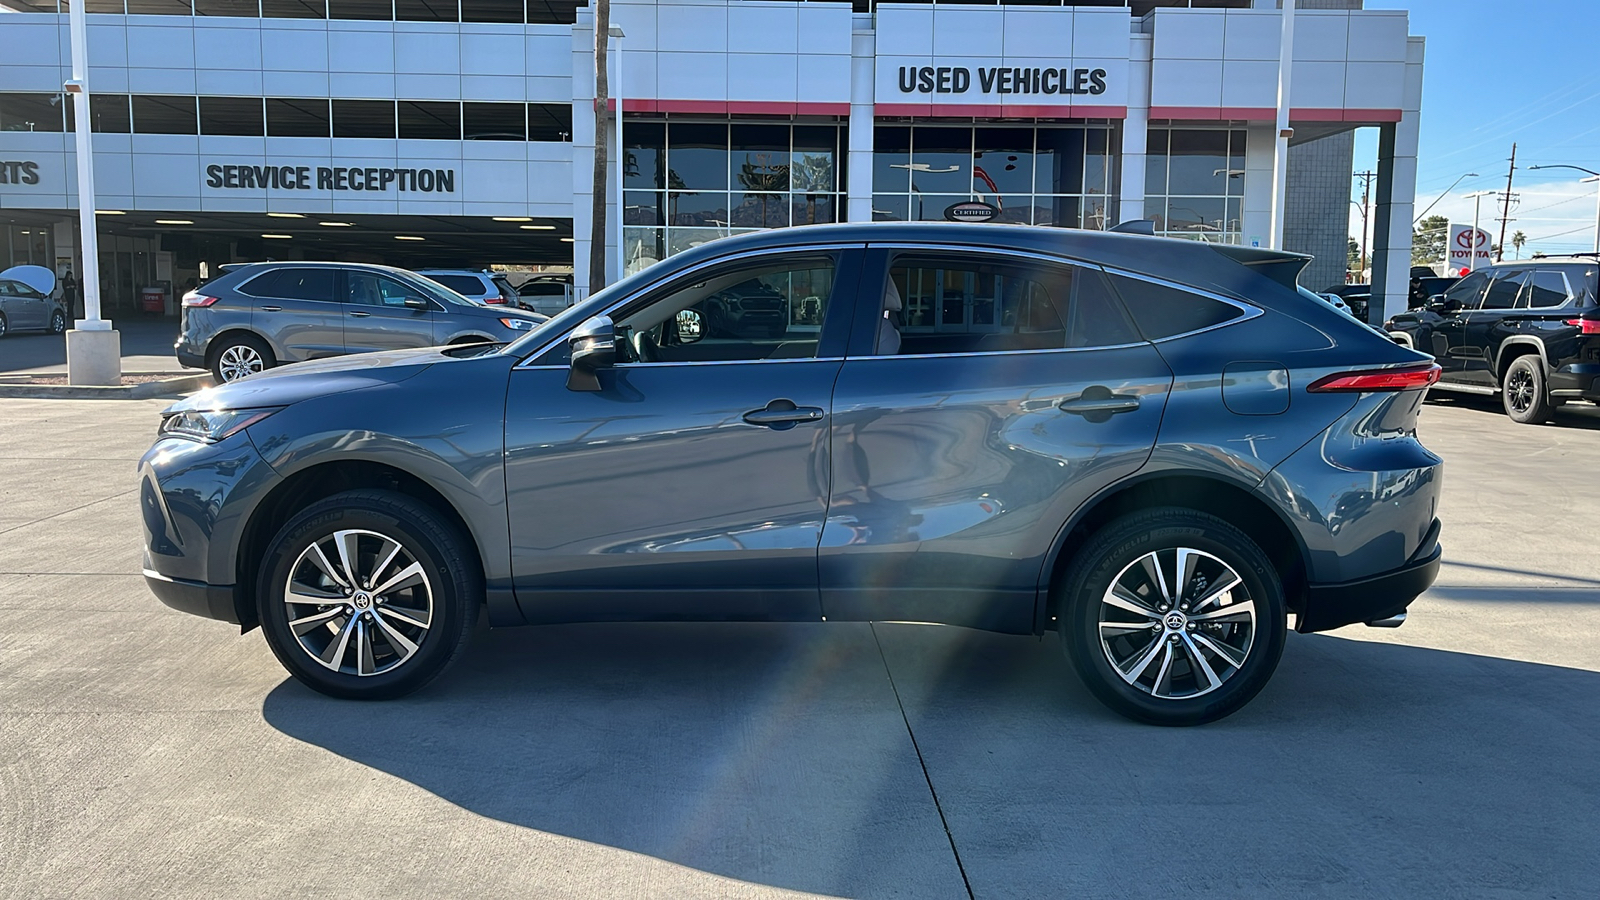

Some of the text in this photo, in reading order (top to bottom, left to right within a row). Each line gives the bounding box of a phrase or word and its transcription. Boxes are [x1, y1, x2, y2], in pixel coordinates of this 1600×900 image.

[899, 66, 1107, 94] USED VEHICLES
[206, 164, 454, 192] SERVICE RECEPTION
[1102, 534, 1149, 570] MICHELIN
